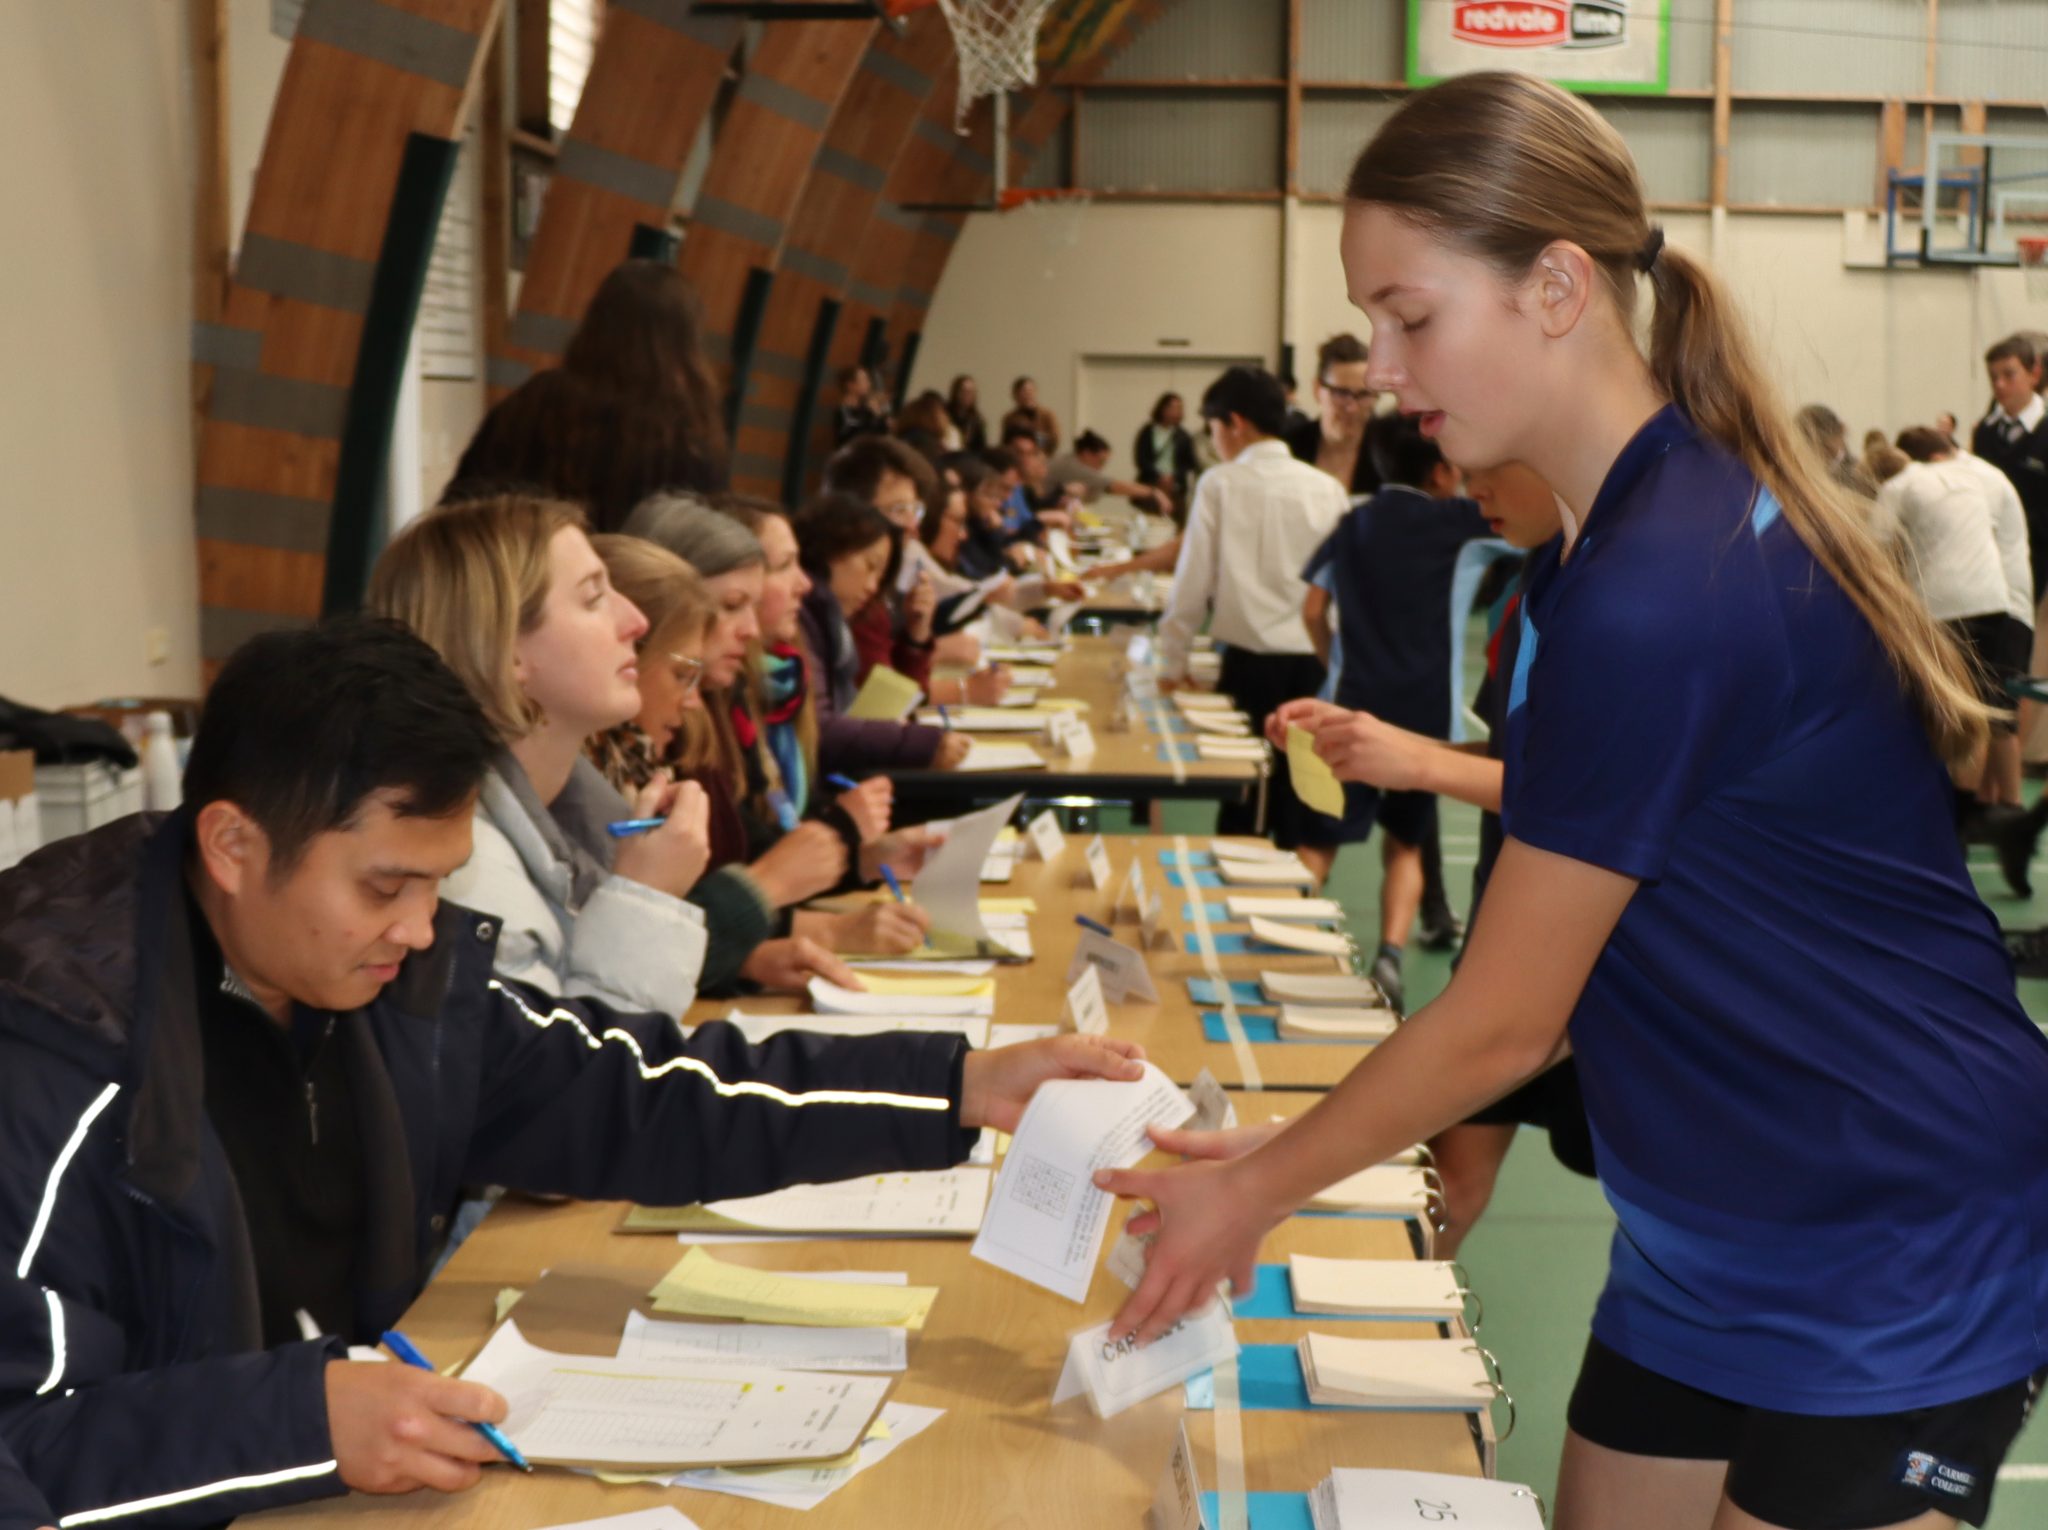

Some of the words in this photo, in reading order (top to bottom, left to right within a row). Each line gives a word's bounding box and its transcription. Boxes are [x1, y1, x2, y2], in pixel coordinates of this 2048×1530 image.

[1463, 6, 1557, 32] redvale
[1574, 9, 1622, 34] lime
[1414, 1499, 1458, 1521] 25
